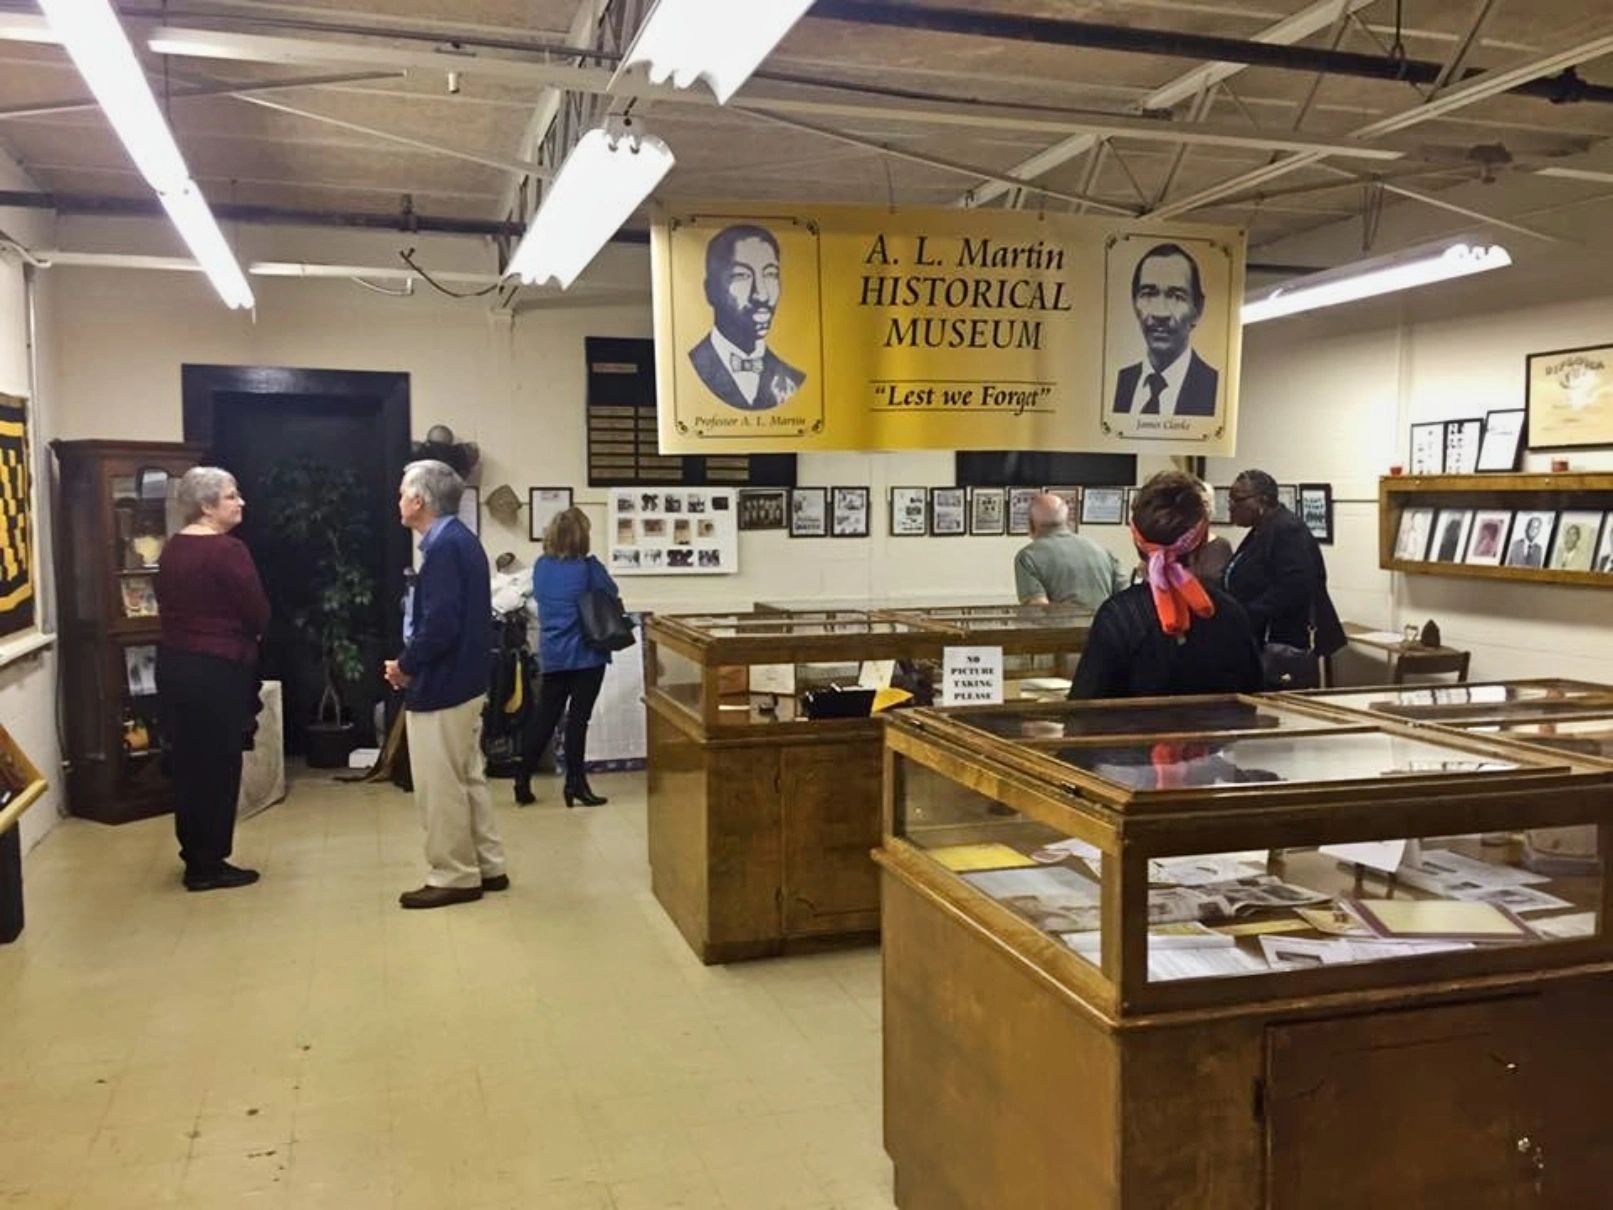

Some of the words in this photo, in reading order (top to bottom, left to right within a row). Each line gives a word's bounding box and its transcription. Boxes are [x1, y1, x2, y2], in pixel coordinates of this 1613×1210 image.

[865, 233, 899, 266] A.
[914, 235, 943, 267] L.
[957, 237, 1065, 270] Martin
[859, 275, 1072, 311] HISTORICAL
[883, 317, 1042, 350] MUSEUM
[943, 390, 973, 407] we
[769, 415, 806, 427] Martin
[967, 655, 981, 663] NO
[951, 667, 993, 675] PICTURE
[954, 680, 992, 688] TAKING
[954, 692, 991, 700] PLEASE
